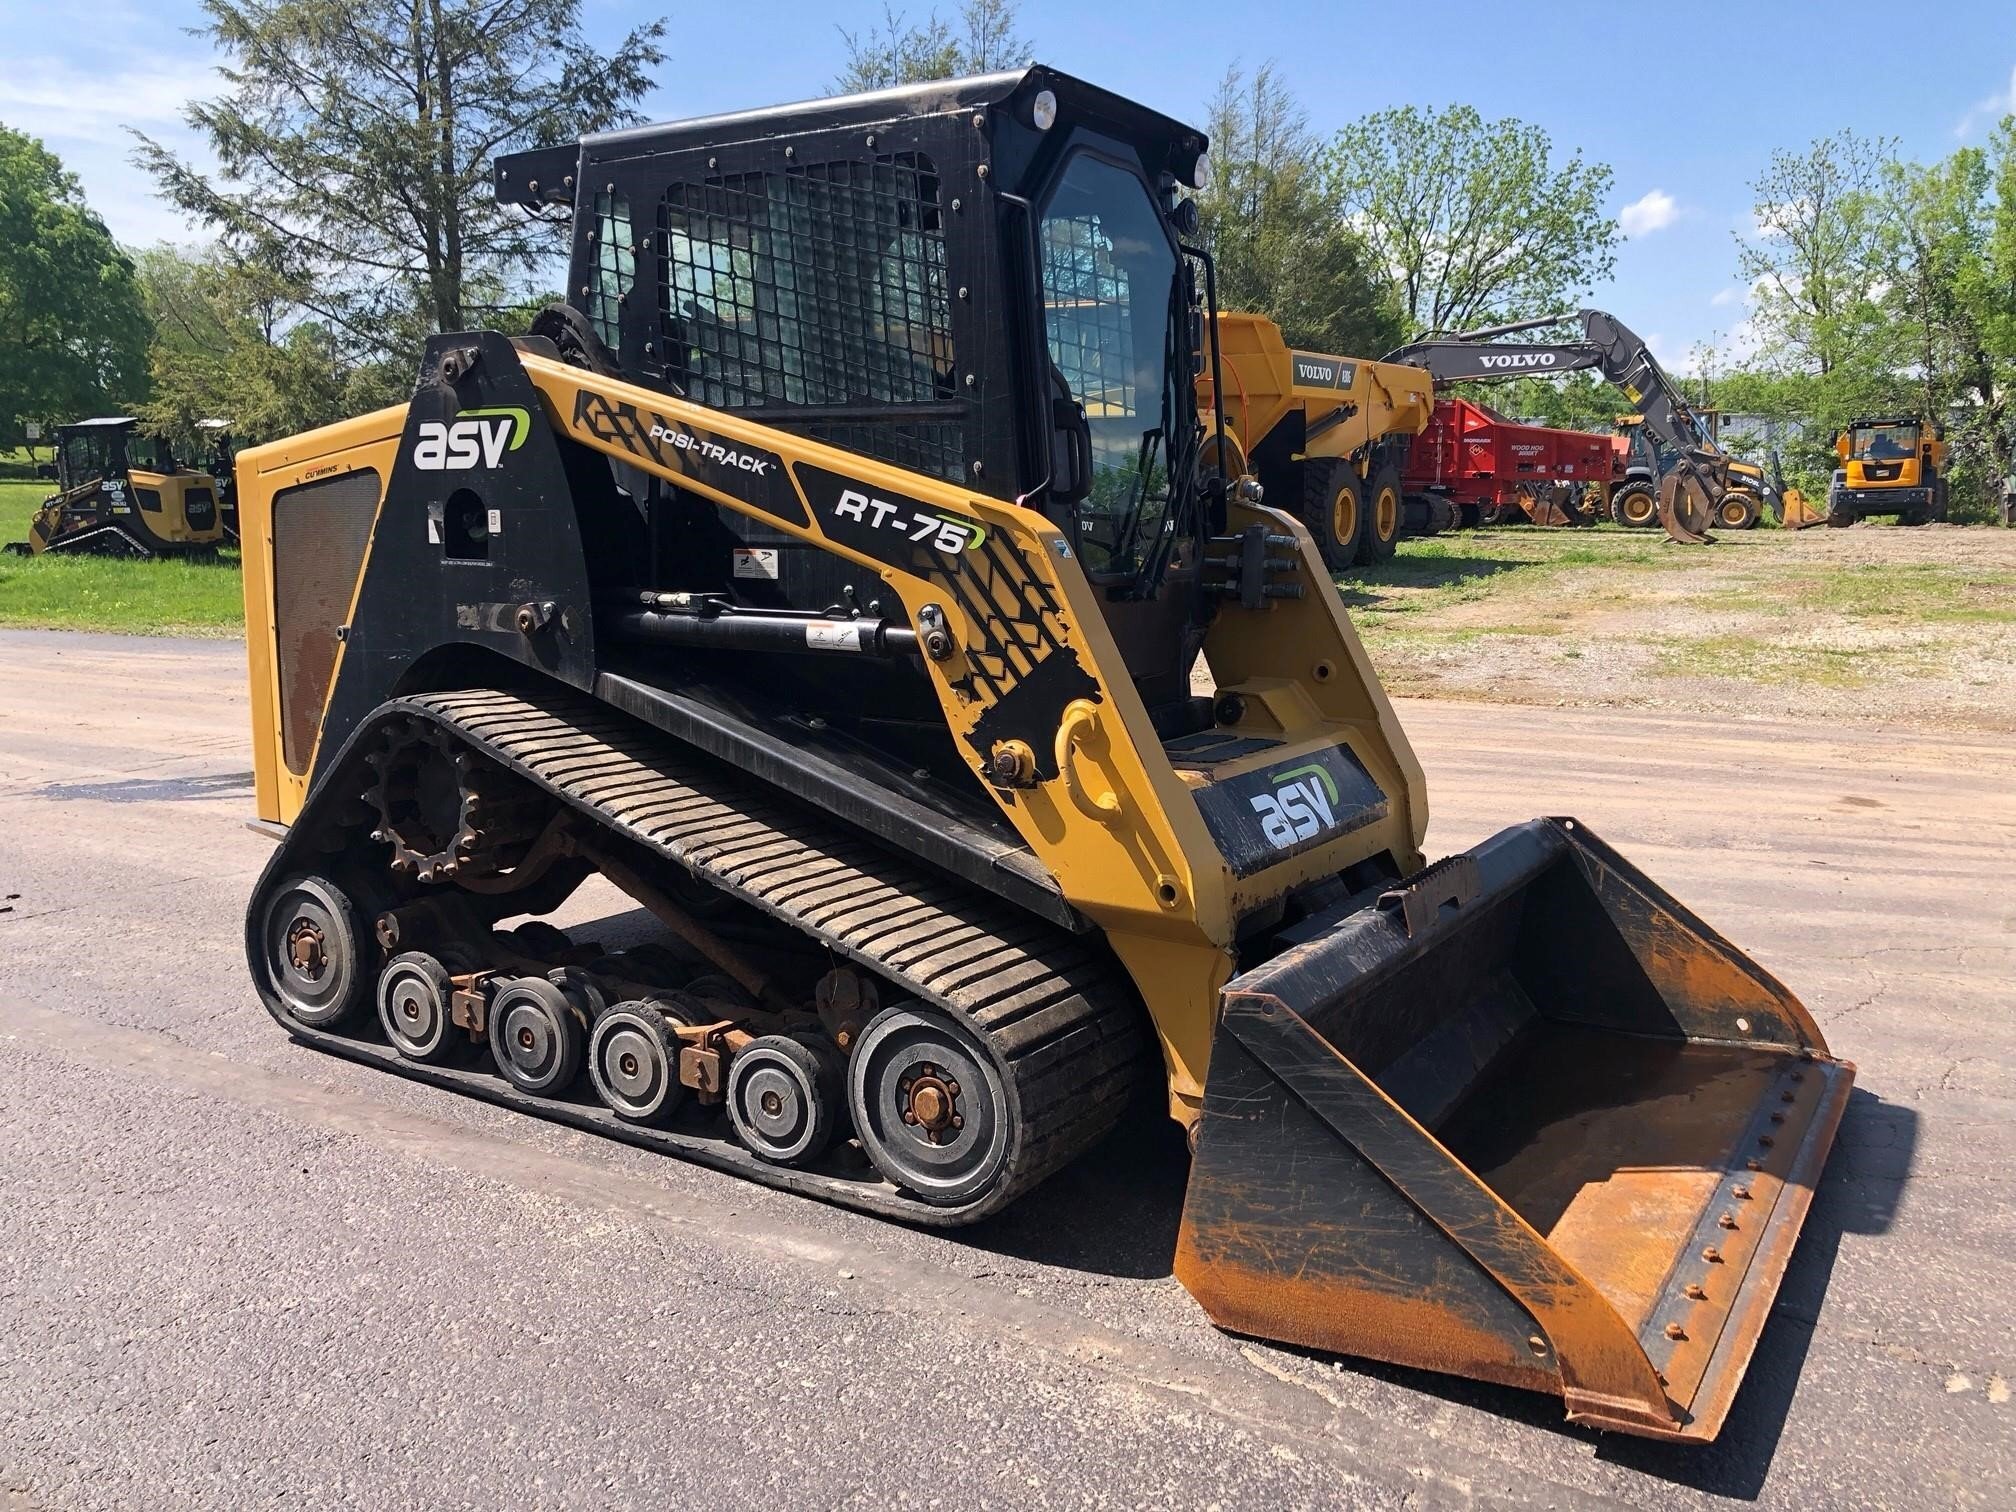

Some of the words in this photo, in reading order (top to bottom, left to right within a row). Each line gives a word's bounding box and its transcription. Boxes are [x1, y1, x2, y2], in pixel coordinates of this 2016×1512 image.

[1298, 364, 1332, 381] VOLVO
[1479, 353, 1556, 368] VOLVO
[649, 425, 769, 476] POSI-TRACK
[834, 490, 969, 554] RT-75
